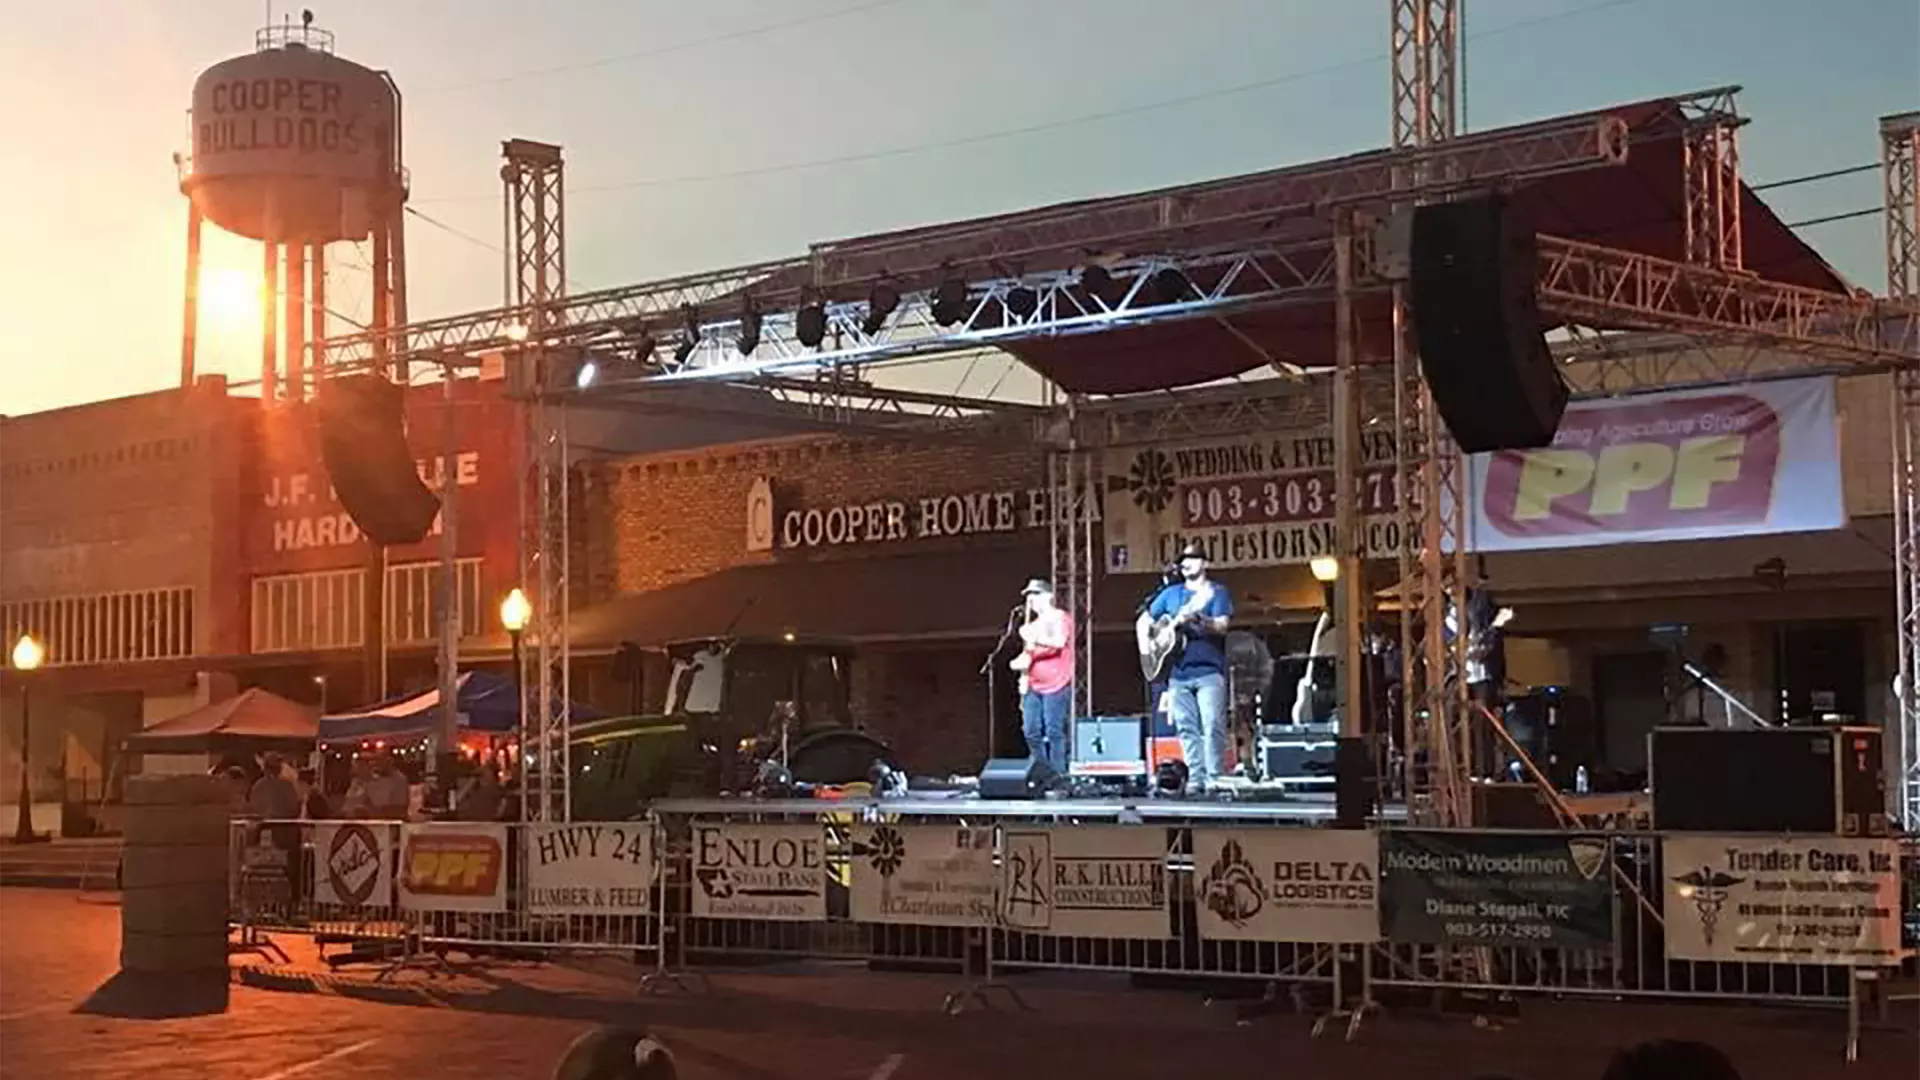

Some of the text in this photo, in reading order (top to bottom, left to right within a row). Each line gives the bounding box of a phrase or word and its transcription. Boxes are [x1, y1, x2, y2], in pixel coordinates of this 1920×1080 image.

[212, 78, 342, 114] COOPER
[199, 117, 359, 155] BULLDOGS
[1176, 442, 1262, 478] WEDDING
[1270, 440, 1285, 469] &
[264, 474, 316, 508] J.F.
[1511, 435, 1745, 521] PPF
[783, 500, 907, 548] COOPER
[918, 491, 1016, 538] HOME
[537, 826, 641, 866] HWY 24
[695, 827, 820, 869] ENLOE
[1387, 850, 1569, 874] Modern Woodmen
[1725, 847, 1804, 871] Tender
[1807, 848, 1866, 874] Care,
[411, 852, 493, 887] PPF
[1274, 861, 1373, 881] DELTA
[529, 886, 648, 907] LUMBER & FEED
[1054, 888, 1151, 904] CONSTRUCTION
[1273, 884, 1374, 900] LOGISTICS
[1424, 898, 1476, 916] Diane
